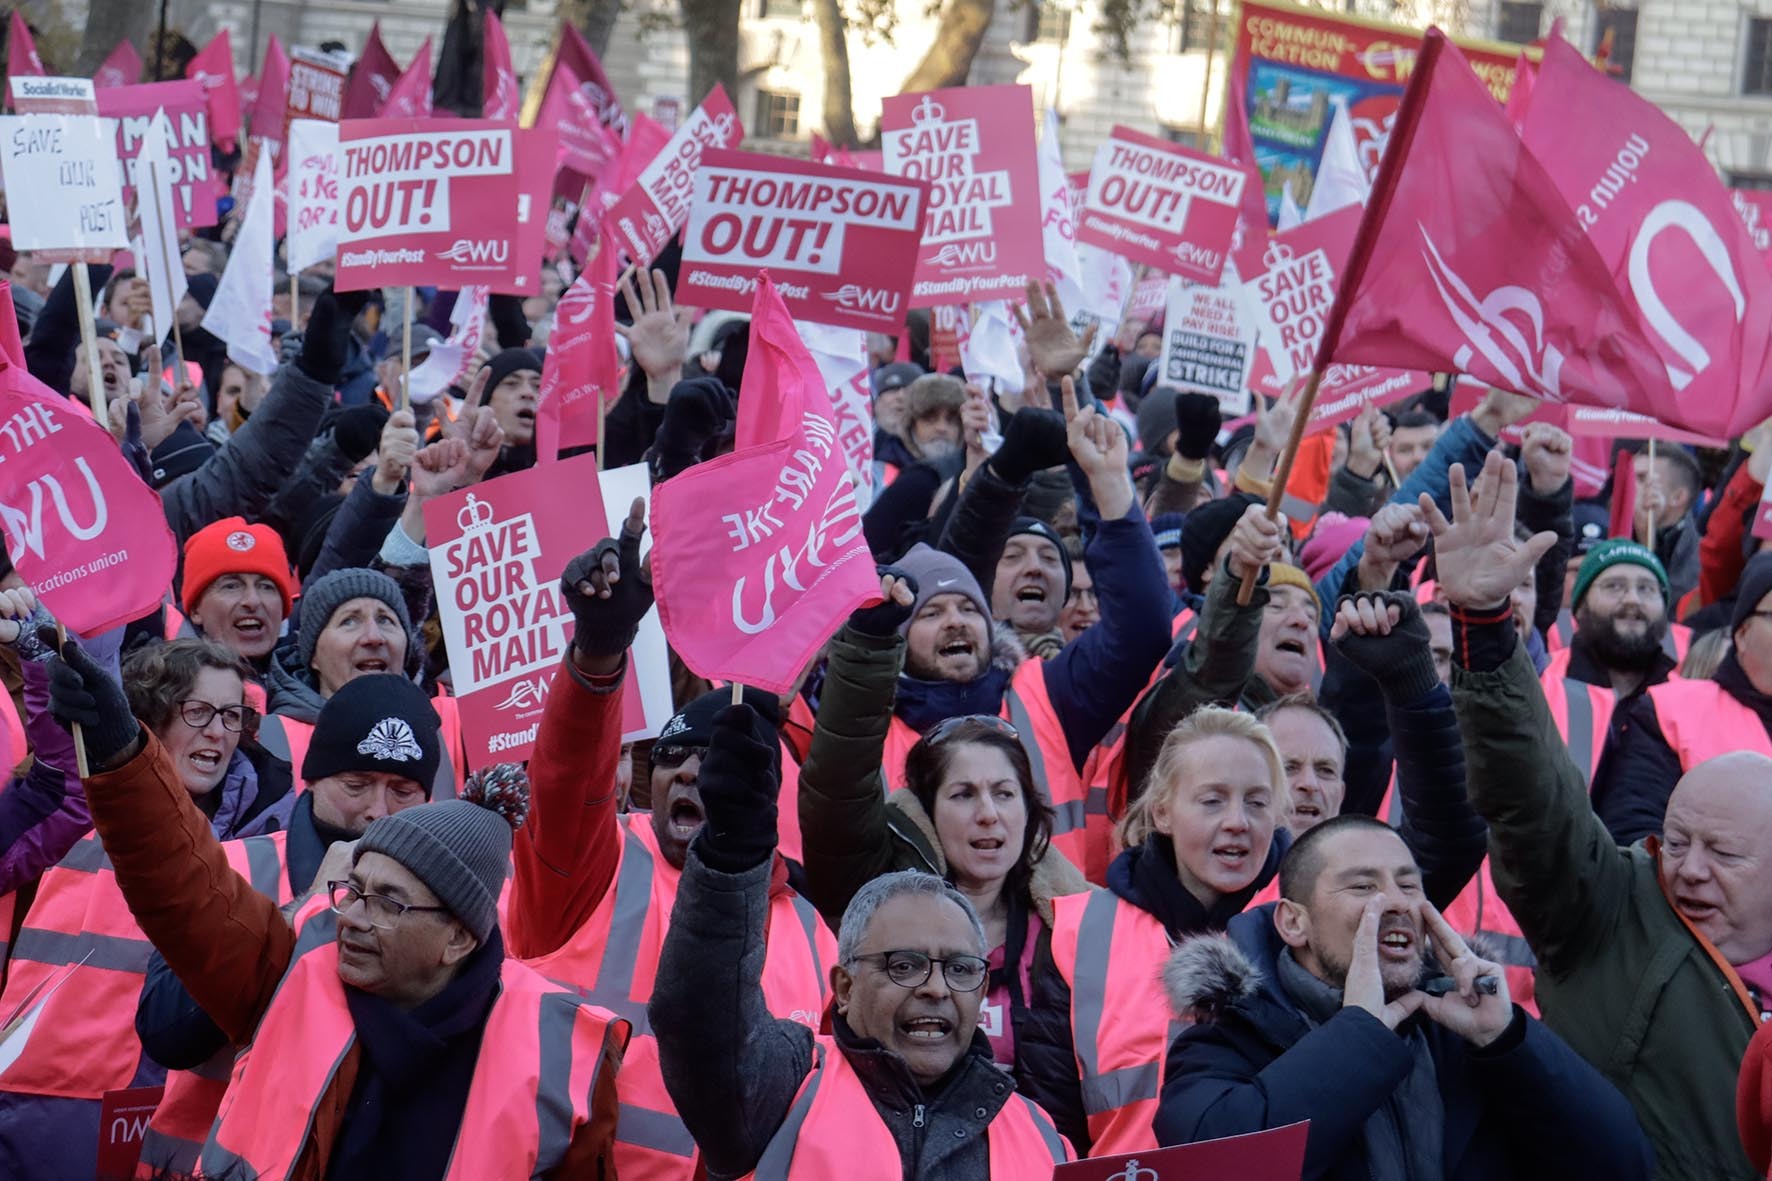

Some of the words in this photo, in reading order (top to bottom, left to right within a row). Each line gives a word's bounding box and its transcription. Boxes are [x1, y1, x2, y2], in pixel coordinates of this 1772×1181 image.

[1251, 36, 1341, 72] ICATION
[13, 127, 63, 157] SAVE
[345, 138, 502, 178] THOMPSON
[897, 124, 973, 158] SAVE
[59, 161, 96, 187] OUR
[902, 153, 964, 181] OUR
[1110, 146, 1237, 198] THOMPSON
[345, 179, 438, 233] OUT!
[707, 175, 910, 221] THOMPSON
[927, 176, 1004, 209] OYAL
[1100, 175, 1182, 224] OUT!
[80, 200, 115, 236] POST
[446, 240, 509, 262] CWU
[701, 212, 833, 264] OUT!
[936, 241, 997, 266] CWU
[688, 271, 809, 299] #StandByYrPost
[913, 274, 1028, 297] #StandByYourPost
[1259, 254, 1324, 303] SAVE
[834, 284, 900, 313] CWU
[1269, 283, 1327, 325] OUR
[1168, 359, 1241, 391] STRIKE
[1312, 372, 1412, 421] StandByYourPost
[89, 549, 128, 574] union
[446, 519, 528, 579] SAVE
[455, 560, 528, 612] OUR
[473, 625, 558, 684] MAIL
